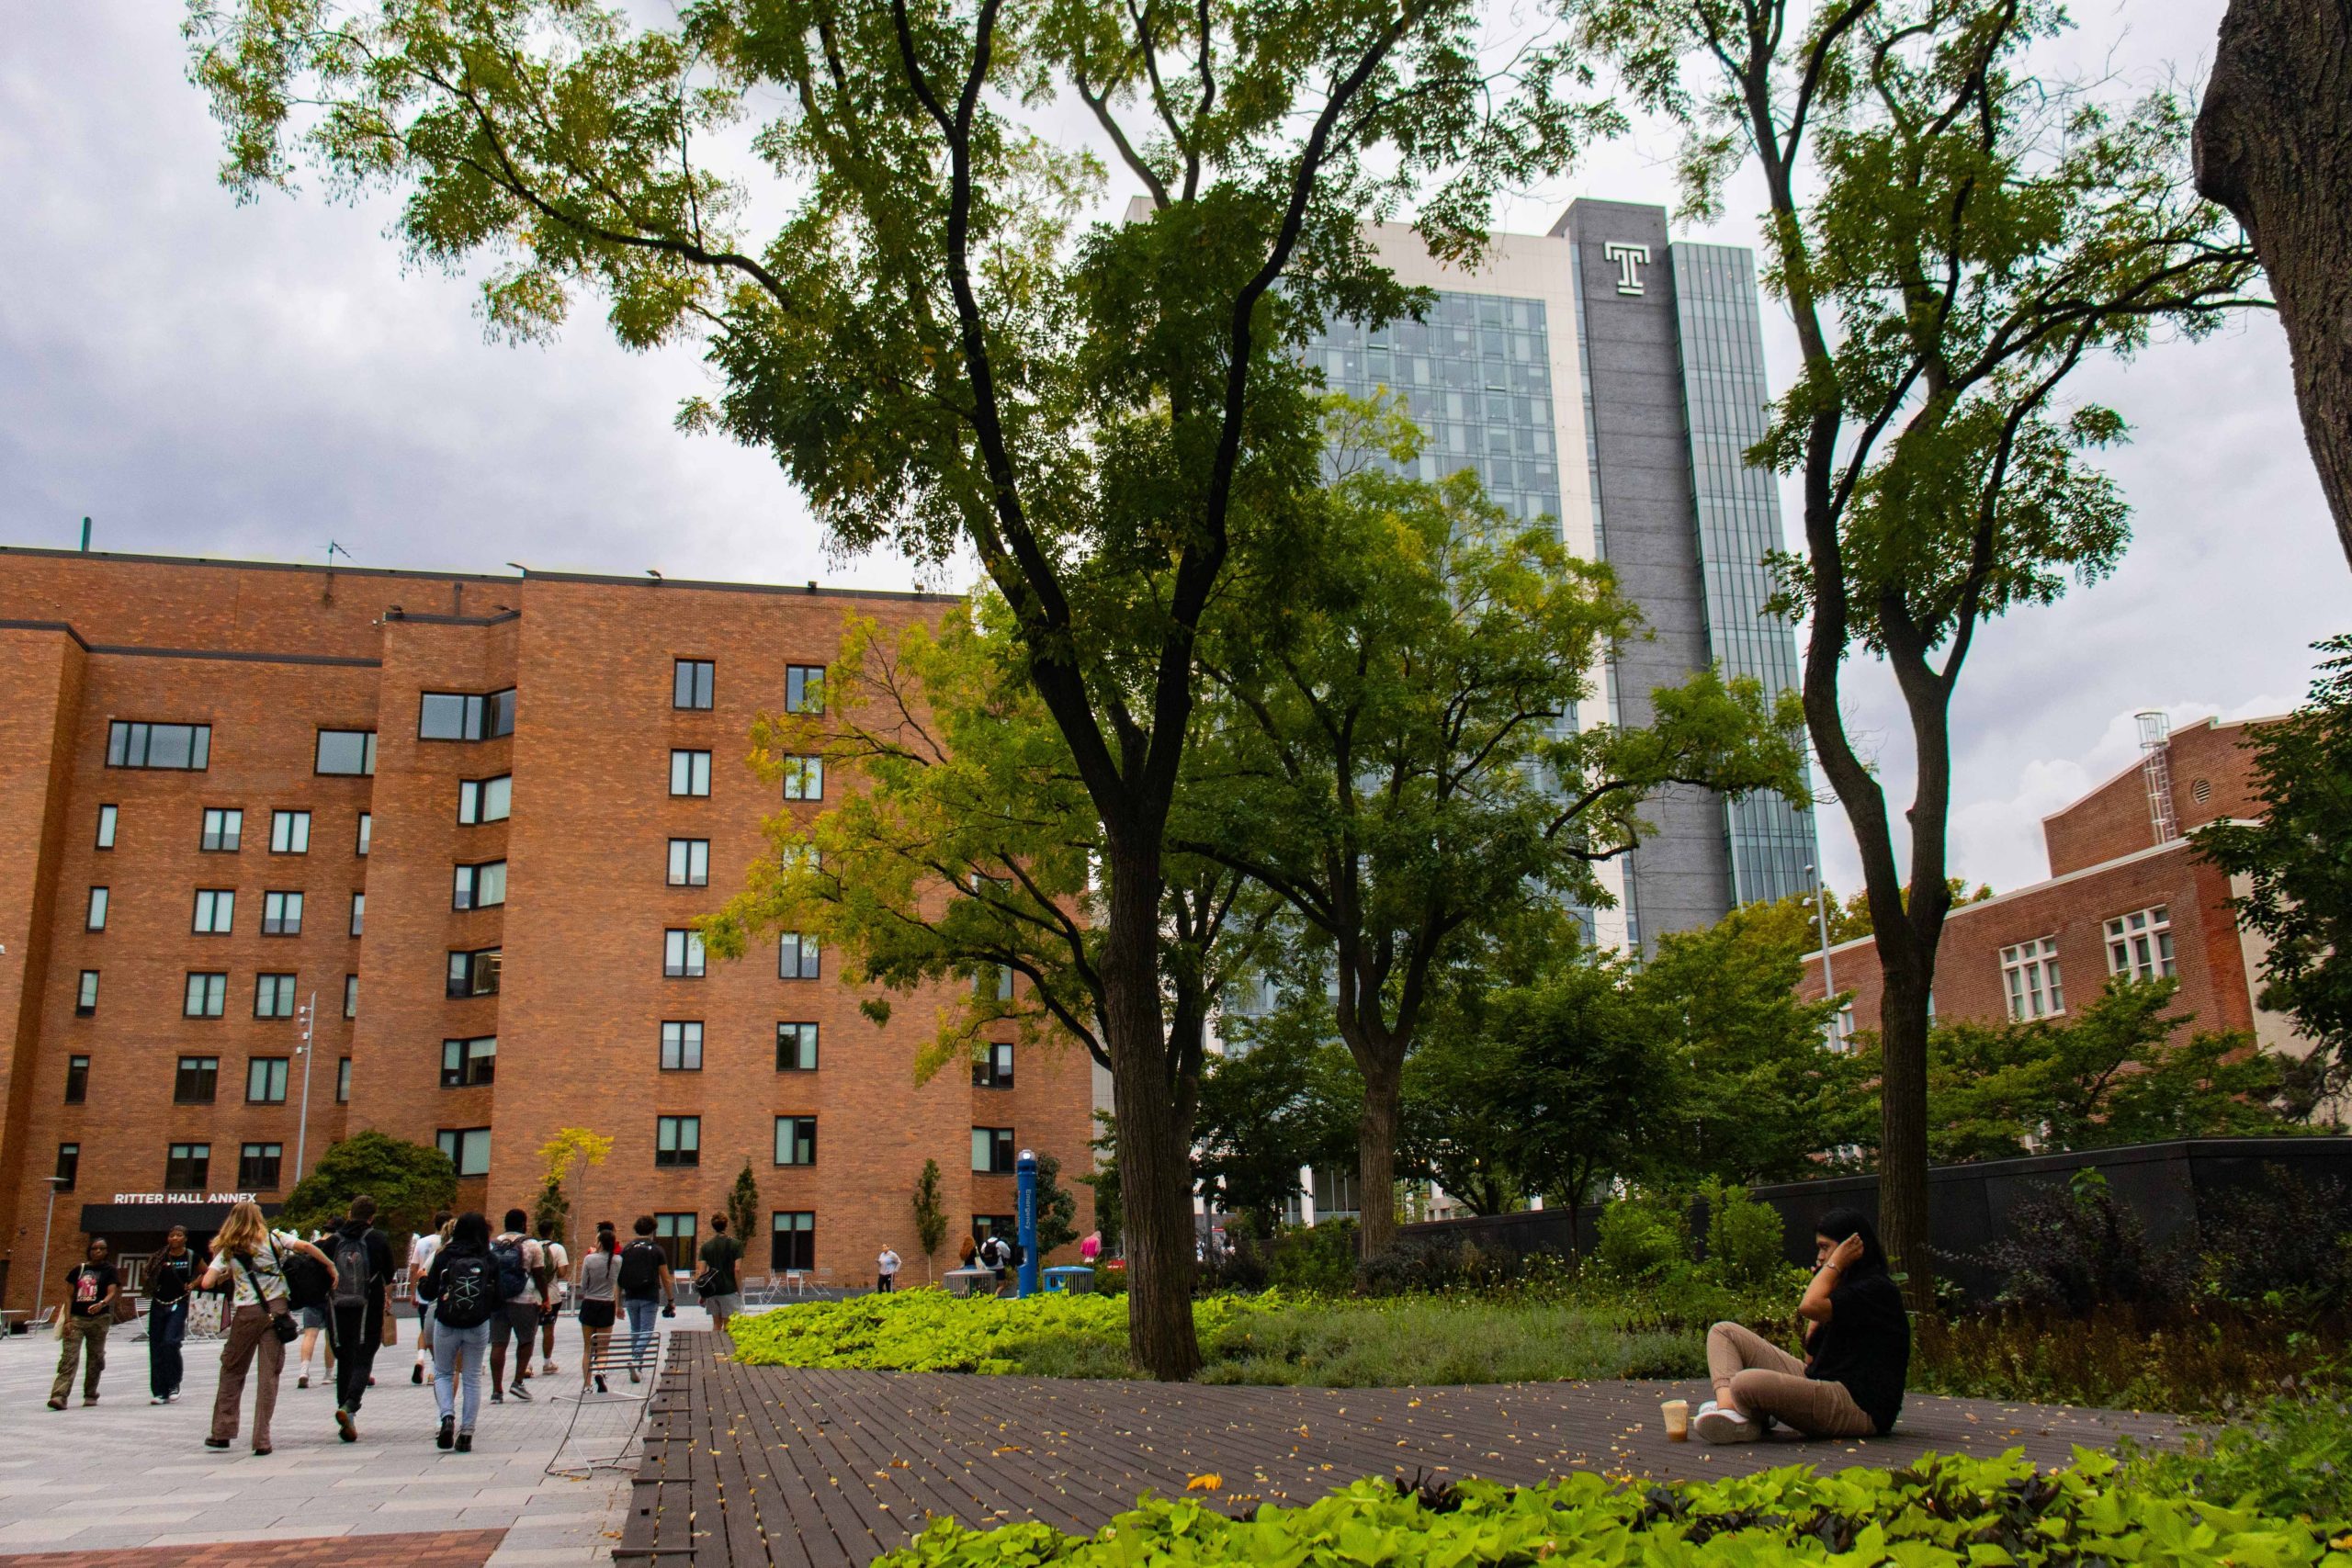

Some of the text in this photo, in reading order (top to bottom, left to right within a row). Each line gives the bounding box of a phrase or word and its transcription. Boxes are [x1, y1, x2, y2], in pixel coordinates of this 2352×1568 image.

[1604, 241, 1650, 295] T
[114, 1192, 256, 1204] RITTER HALL ANNEX
